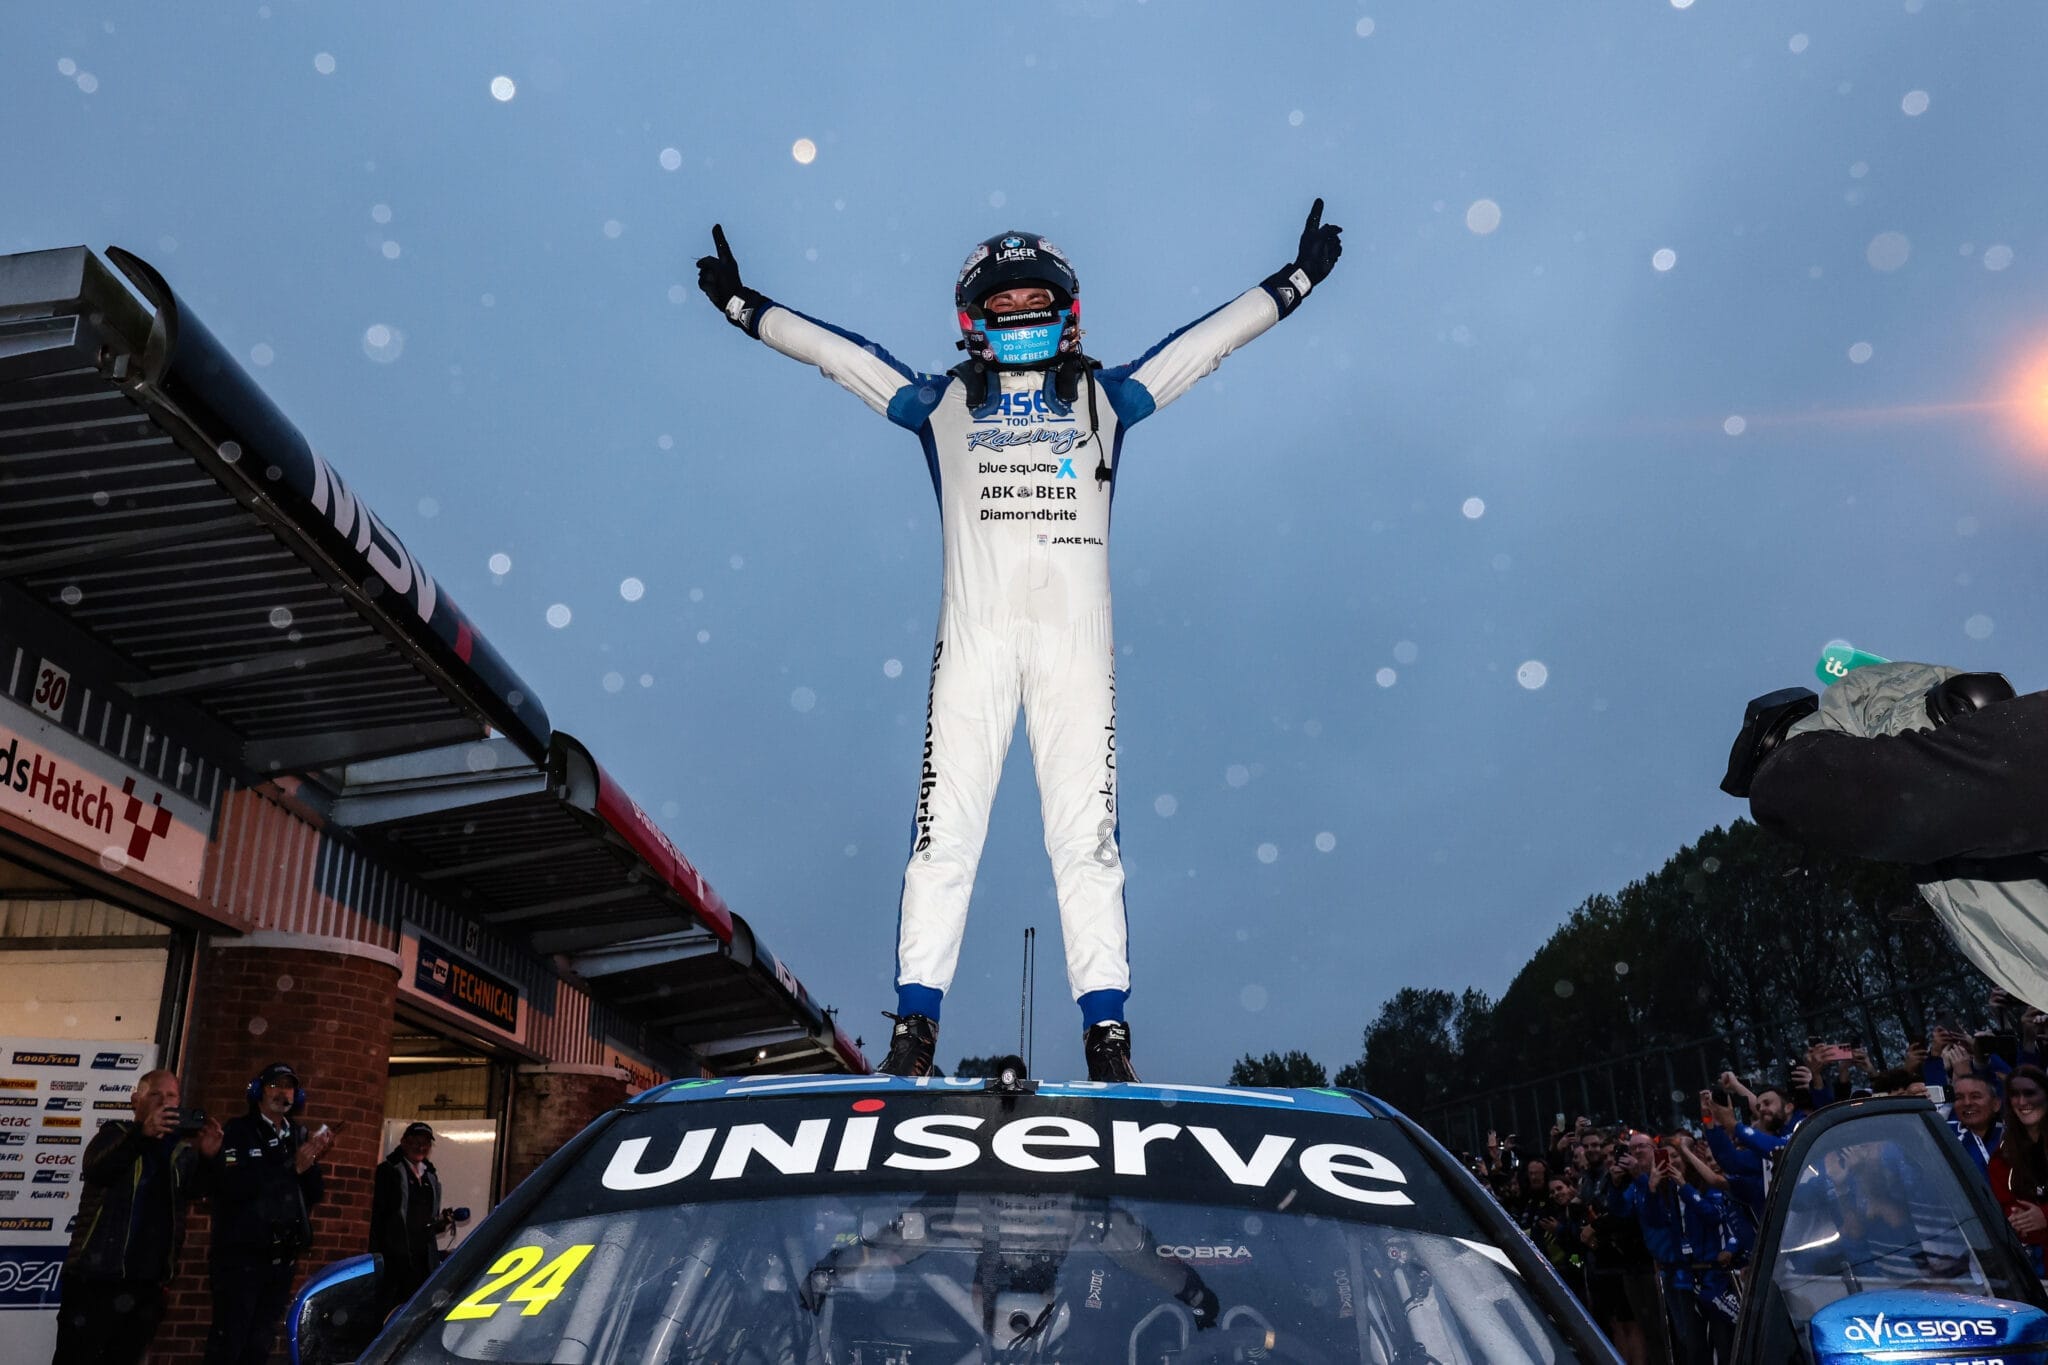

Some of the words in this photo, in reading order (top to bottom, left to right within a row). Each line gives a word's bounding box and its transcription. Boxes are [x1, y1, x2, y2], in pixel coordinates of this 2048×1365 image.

[996, 248, 1037, 261] LASER
[997, 311, 1052, 323] Diamondbrite
[1005, 415, 1045, 427] TOOLS
[967, 427, 1086, 455] Racing
[978, 462, 1008, 473] blue
[980, 486, 1014, 500] ABK
[1036, 486, 1077, 499] BEER
[980, 509, 1077, 521] Diamondbrite
[1083, 537, 1103, 545] HILL
[35, 667, 67, 712] 30
[452, 963, 514, 1022] TECHNICAL
[15, 1055, 78, 1064] GOODYEAR
[119, 1057, 139, 1065] BTCC
[0, 1115, 32, 1127] etac
[35, 1152, 77, 1165] Getac
[1156, 1245, 1252, 1259] COBRA
[444, 1244, 595, 1321] 24
[1917, 1320, 1997, 1341] signs
